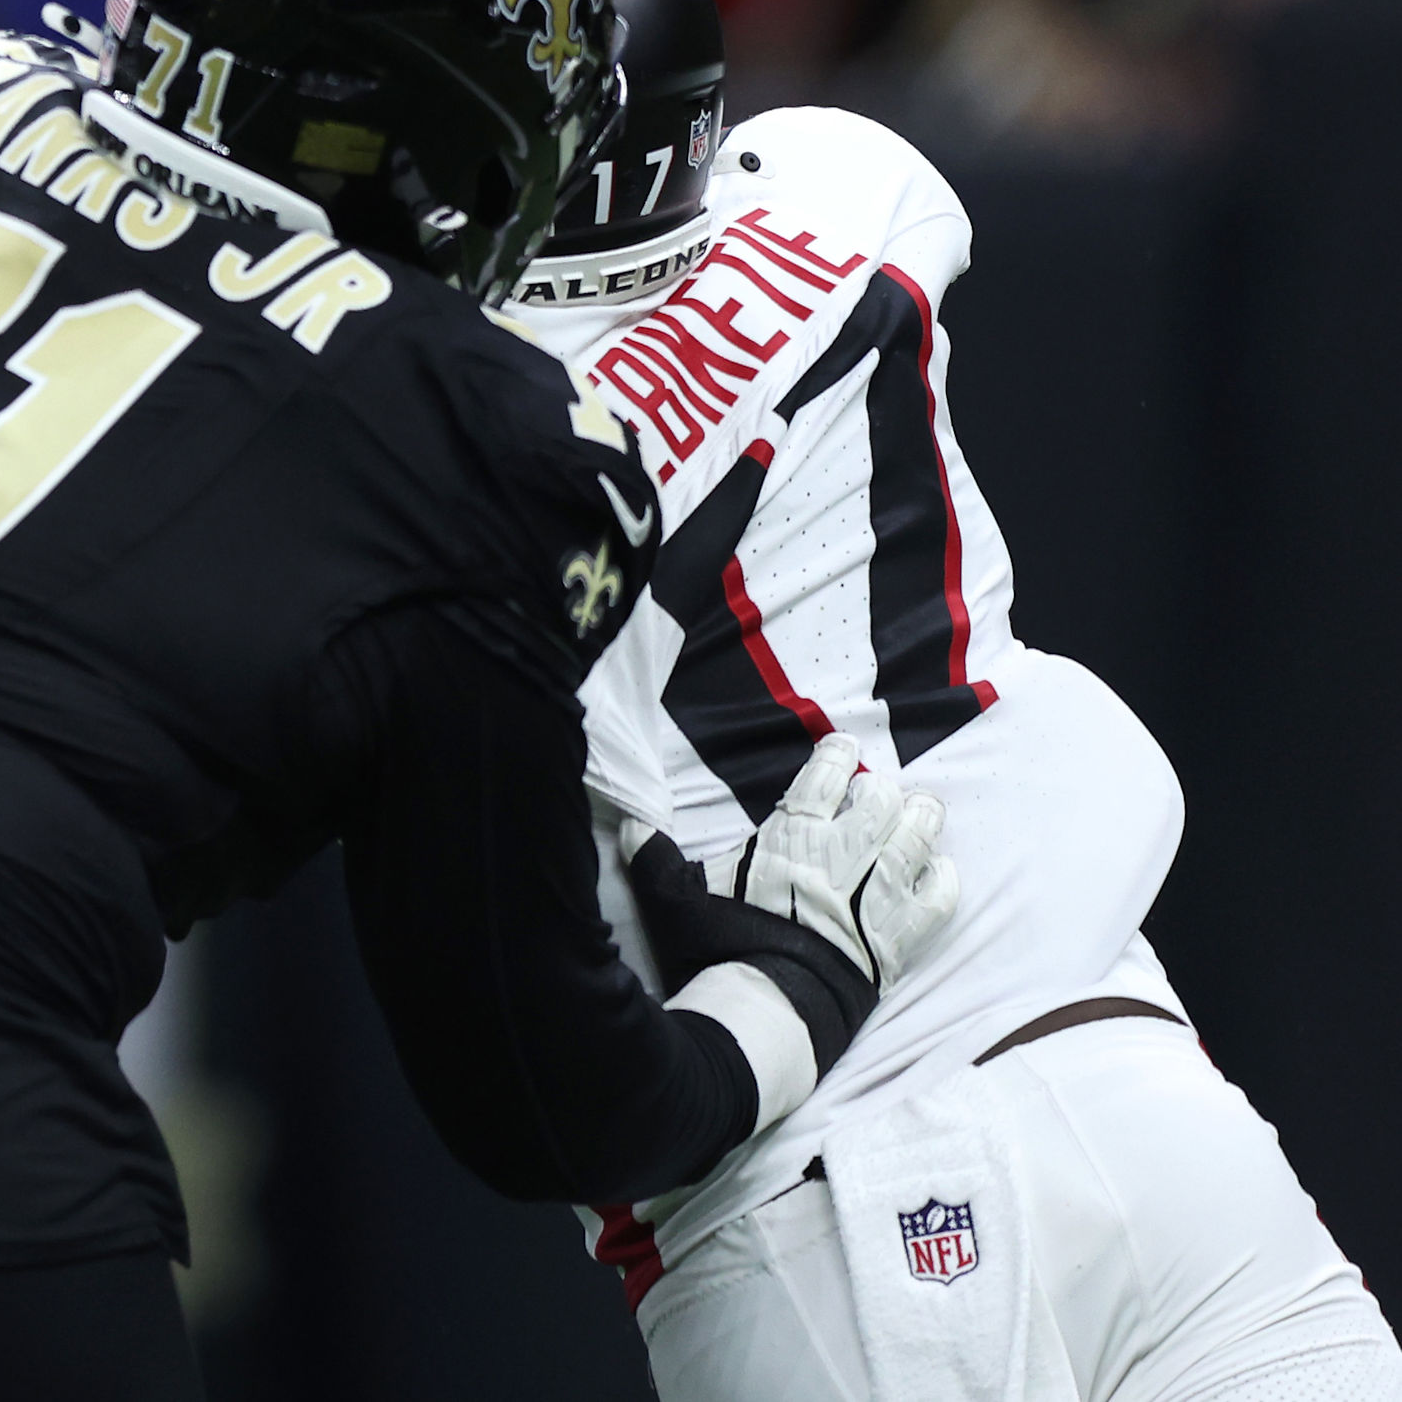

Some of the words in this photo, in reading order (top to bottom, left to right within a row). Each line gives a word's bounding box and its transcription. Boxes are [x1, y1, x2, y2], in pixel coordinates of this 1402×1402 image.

[133, 13, 237, 144] 71
[590, 144, 676, 225] 17
[208, 229, 393, 355] JR
[508, 237, 709, 303] ALCONS
[587, 208, 868, 486] BIKETIE
[910, 1233, 973, 1276] NFL
